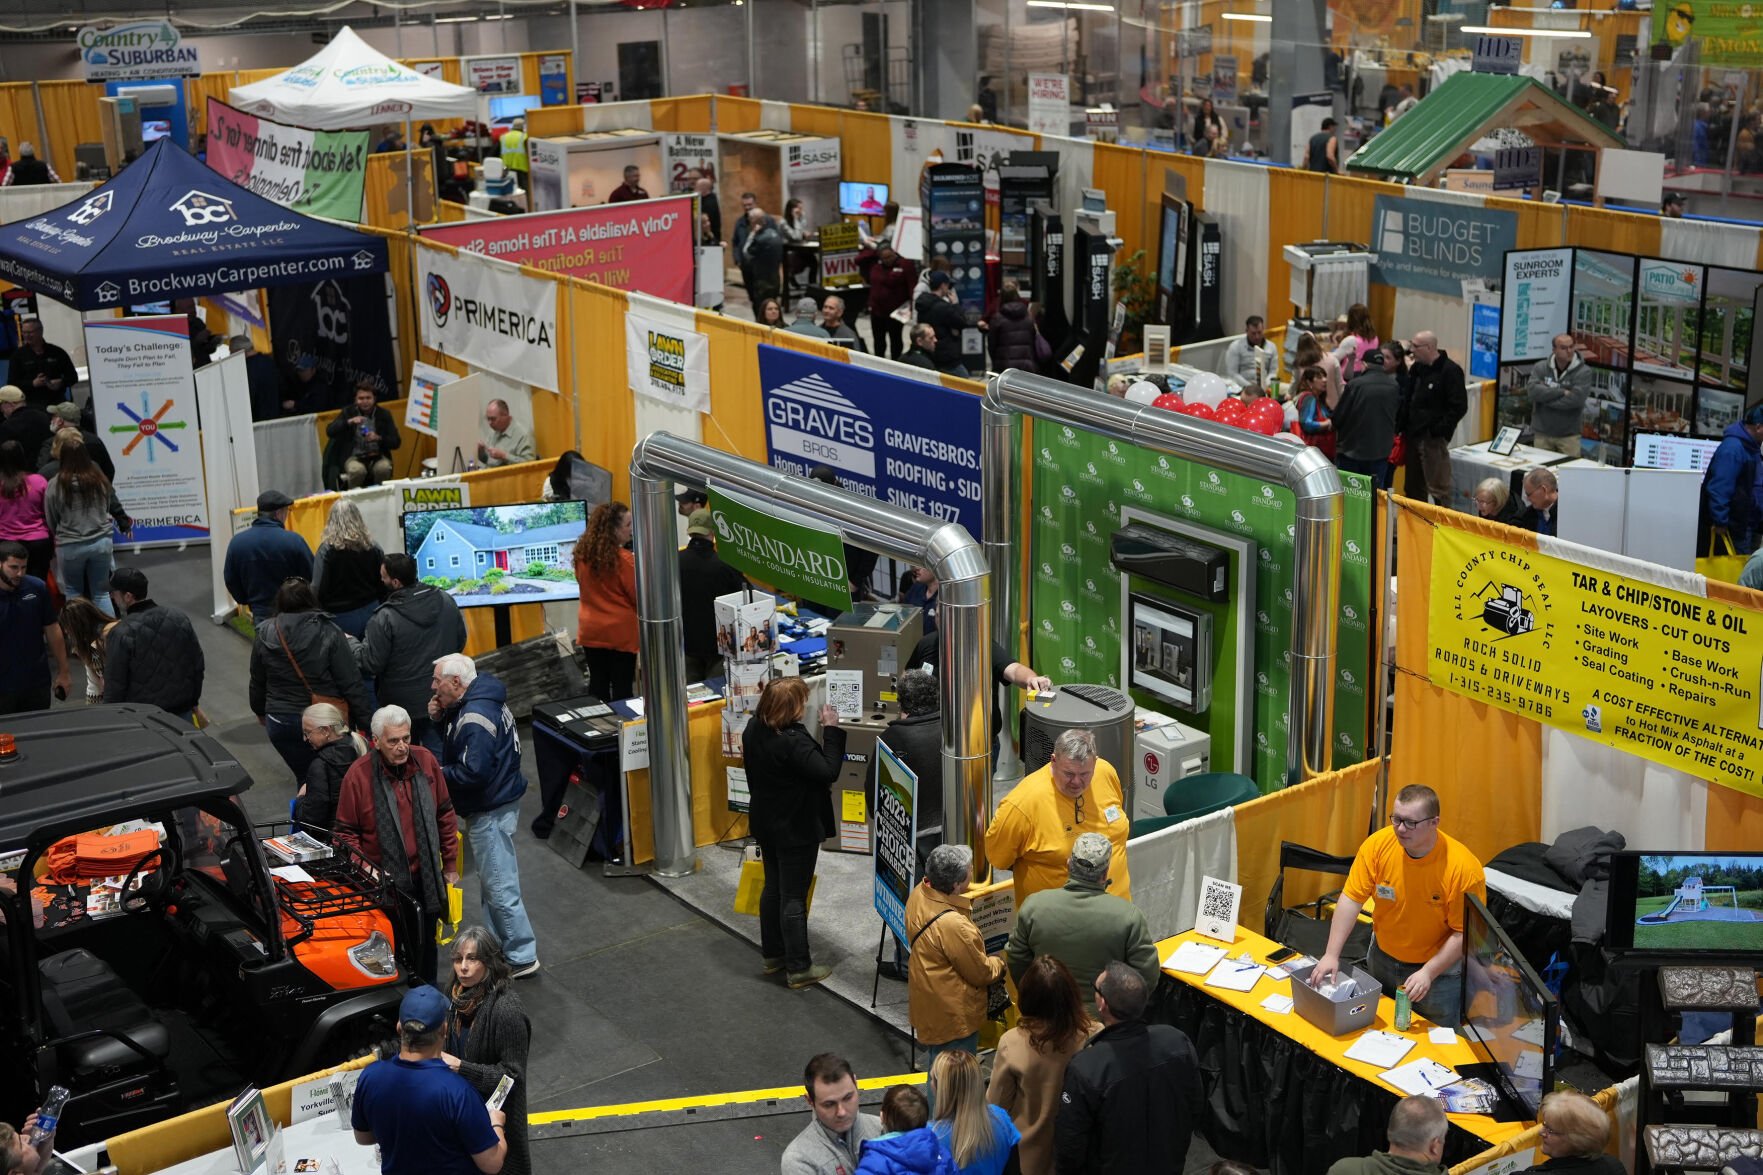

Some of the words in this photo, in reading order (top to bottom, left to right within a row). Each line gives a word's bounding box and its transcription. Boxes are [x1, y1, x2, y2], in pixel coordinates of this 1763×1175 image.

[80, 31, 158, 49] Country
[108, 47, 197, 65] SUBURBAN
[802, 152, 837, 165] SASH
[1408, 213, 1495, 244] BUDGET
[172, 248, 206, 257] REAL
[211, 241, 257, 252] ESTATE
[262, 238, 285, 246] LLC
[1047, 244, 1056, 277] SASH
[1408, 237, 1482, 266] BLINDS
[128, 256, 345, 296] BrockwayCarpenter.com
[1203, 254, 1212, 287] SASH
[1514, 259, 1563, 271] SUNROOM
[1516, 269, 1560, 280] EXPERTS
[1091, 266, 1100, 300] SASH
[1650, 272, 1675, 286] PATIO
[454, 295, 552, 349] PRIMERICA
[96, 344, 131, 354] Today's
[134, 342, 183, 352] Challenge:
[648, 330, 685, 357] LAWN
[649, 347, 685, 372] ORDER
[140, 423, 156, 431] YOU
[768, 398, 874, 448] GRAVES
[803, 439, 841, 462] BROS.
[774, 455, 803, 478] Home
[886, 458, 945, 491] ROOFING
[402, 487, 462, 502] LAWN
[1200, 481, 1227, 494] STANDARD
[1343, 486, 1371, 498] TANDARD
[887, 488, 926, 515] SINCE
[928, 500, 960, 524] 1977
[1252, 496, 1282, 508] STANDARD
[136, 514, 201, 527] PRIMERICA
[732, 522, 843, 581] STANDARD
[1342, 551, 1367, 564] ANDARD
[1500, 552, 1530, 572] CHIP
[737, 547, 761, 565] HEATING
[767, 561, 796, 578] COOLING
[802, 575, 847, 593] INSULATING
[1457, 550, 1495, 588] COUNTY
[1533, 574, 1552, 611] SEAL
[1572, 572, 1598, 592] TAR
[1602, 581, 1611, 596] &
[1616, 585, 1701, 622] CHIP/STONE
[1706, 610, 1716, 626] &
[1722, 614, 1748, 634] OIL
[1455, 594, 1463, 621] ALL
[1543, 623, 1554, 650] LLC
[1581, 601, 1649, 630] LAYOVERS
[1661, 625, 1688, 641] CUT
[1692, 634, 1730, 653] OUTS
[1584, 624, 1605, 639] Site
[1609, 631, 1639, 649] Work
[1503, 650, 1541, 673] SOLID
[1583, 640, 1628, 665] Grading
[1672, 650, 1702, 667] Base
[1706, 660, 1739, 679] Work
[1435, 648, 1475, 671] ROADS
[1481, 664, 1487, 675] &
[1494, 668, 1570, 703] DRIVEWAYS
[1582, 656, 1605, 672] Seal
[1609, 665, 1654, 690] Coating
[1670, 667, 1751, 699] Crush-n-Run
[1450, 672, 1552, 718] 1-315-235-9786
[1669, 683, 1717, 707] Repairs
[1592, 689, 1600, 700] A
[1603, 692, 1633, 710] COST
[1636, 703, 1699, 730] EFFECTIVE
[1702, 723, 1763, 751] ALTERNAT
[1626, 716, 1636, 726] to
[1639, 719, 1658, 732] Hot
[1661, 726, 1679, 738] Mix
[1682, 732, 1722, 753] Asphalt
[1725, 748, 1735, 757] at
[1737, 752, 1744, 760] a
[847, 754, 866, 762] YORK
[1615, 726, 1672, 751] FRACTION
[1675, 744, 1691, 758] OF
[1694, 751, 1716, 767] THE
[1719, 761, 1755, 781] COST!
[1145, 775, 1158, 790] LG
[884, 788, 906, 826] 2023
[875, 810, 915, 877] CHOICE
[880, 844, 906, 880] AWARDS
[300, 1098, 334, 1112] Yorkville
